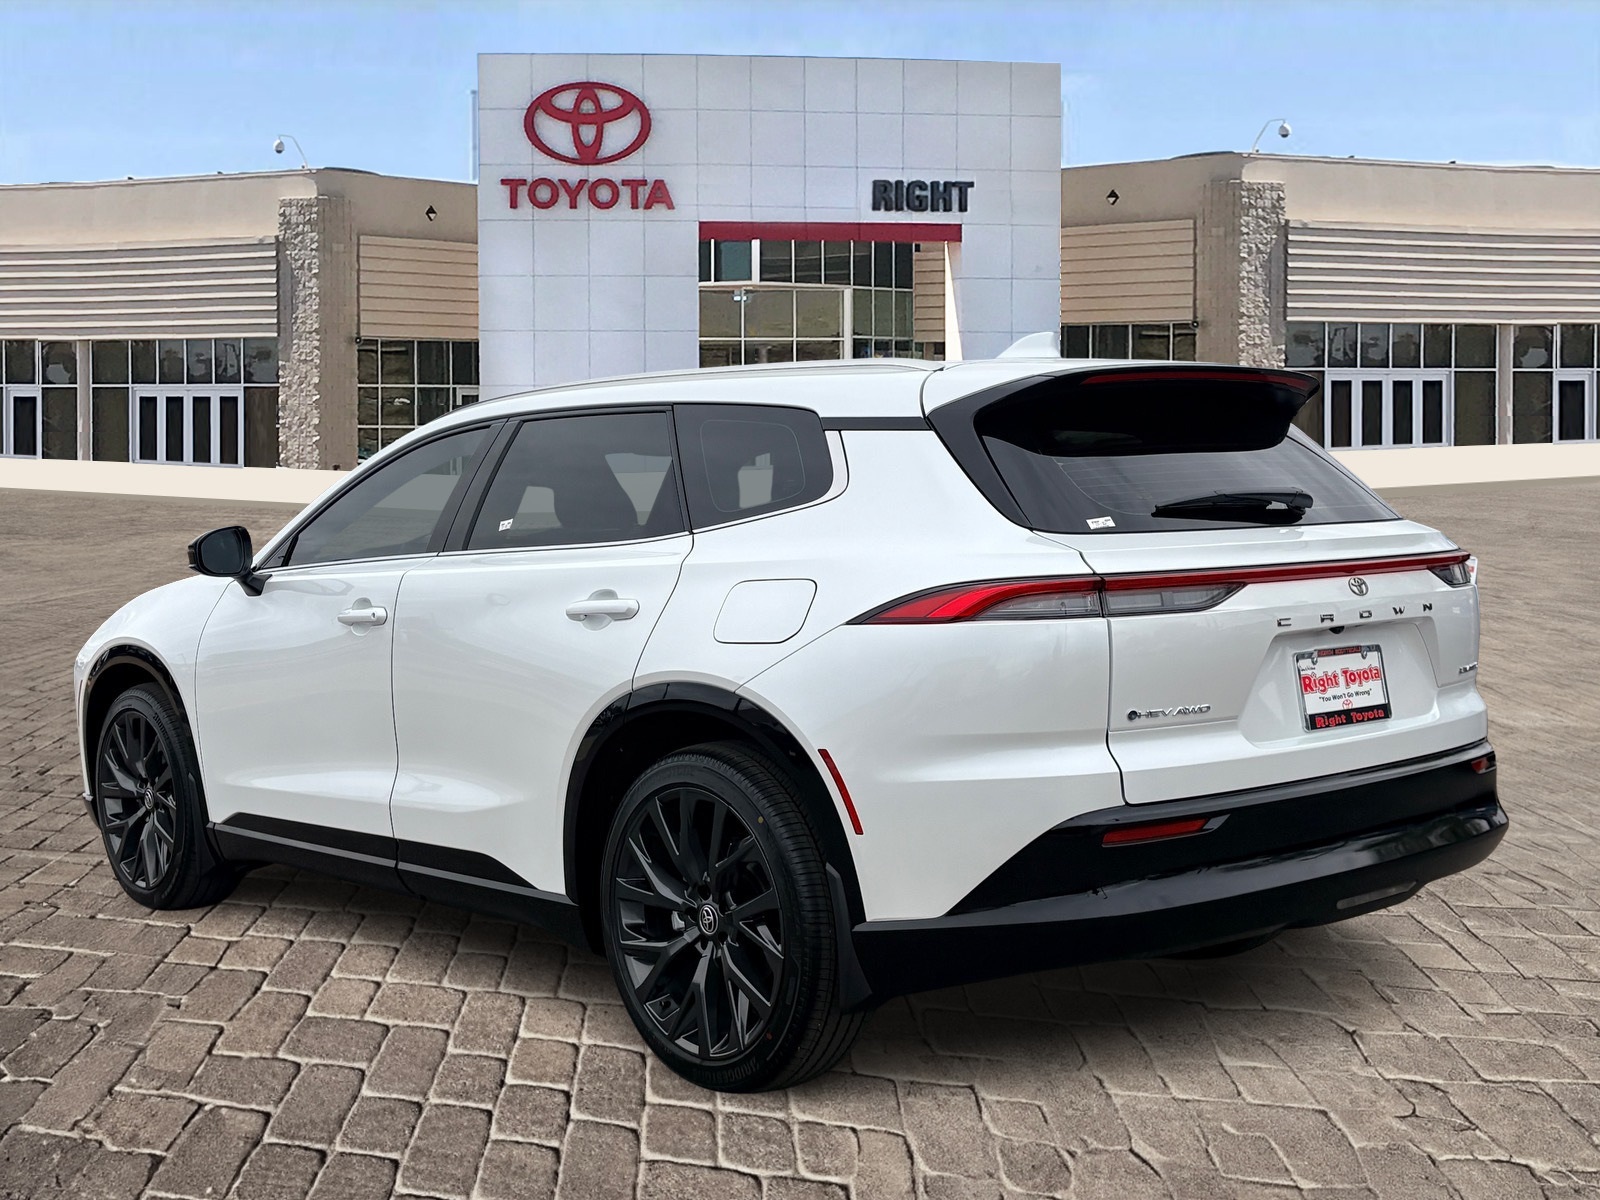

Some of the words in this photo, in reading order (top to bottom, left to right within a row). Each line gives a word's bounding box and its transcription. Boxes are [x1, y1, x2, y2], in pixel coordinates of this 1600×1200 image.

[501, 178, 675, 211] TOYOTA
[872, 180, 975, 213] RIGHT
[1277, 602, 1433, 628] CROWN
[1301, 671, 1340, 695] Right
[1340, 664, 1382, 689] Toyota
[1315, 714, 1347, 728] Right
[1350, 708, 1385, 723] Toyota
